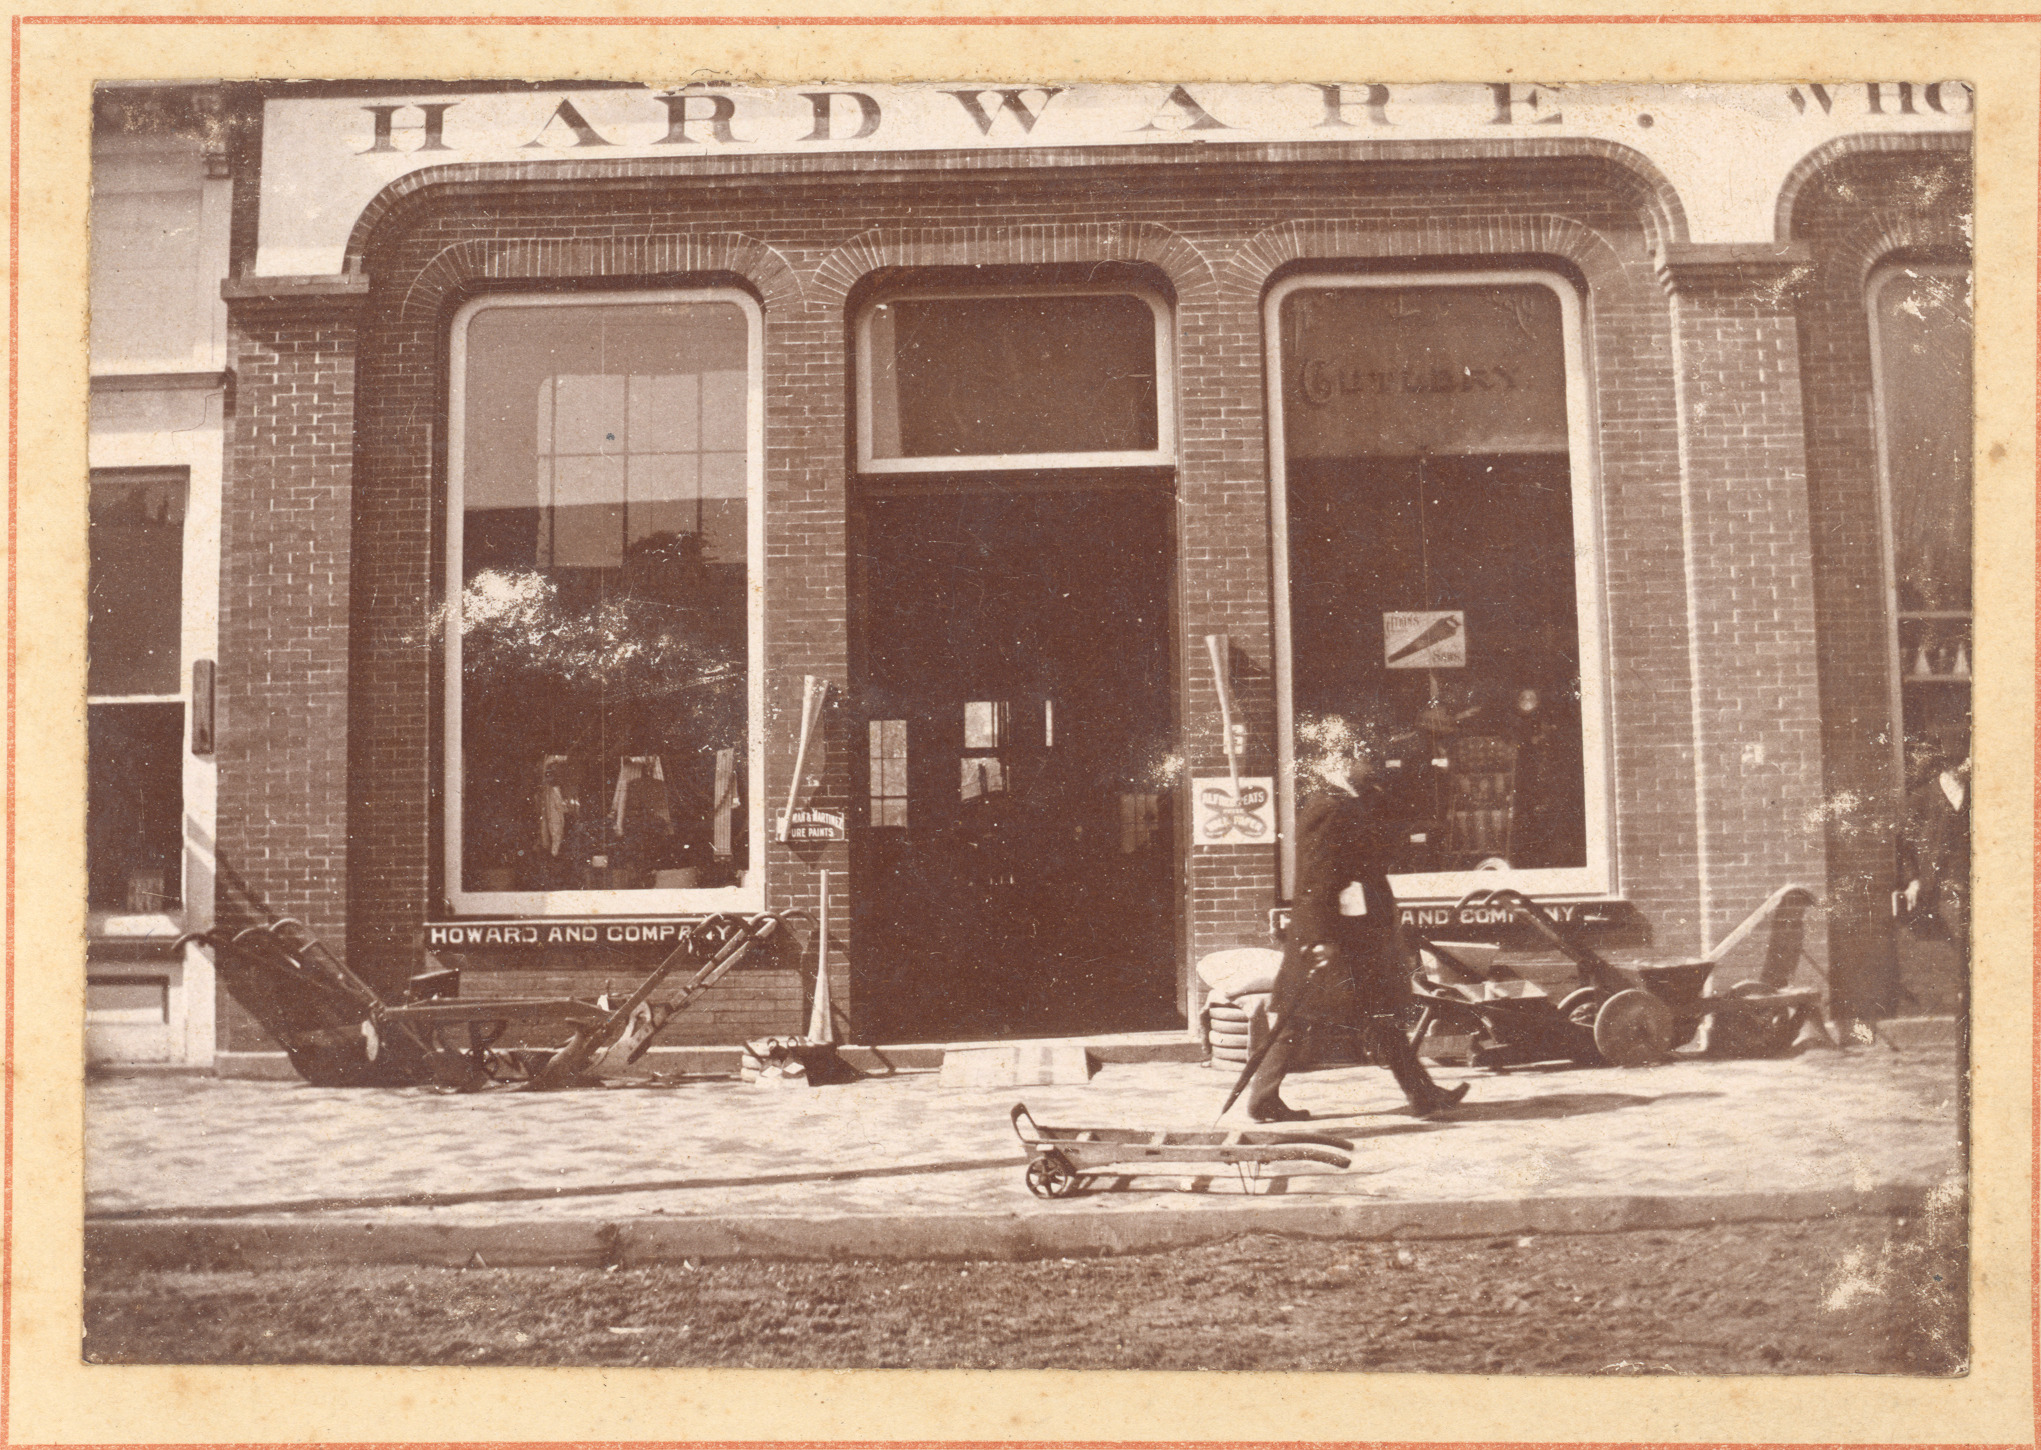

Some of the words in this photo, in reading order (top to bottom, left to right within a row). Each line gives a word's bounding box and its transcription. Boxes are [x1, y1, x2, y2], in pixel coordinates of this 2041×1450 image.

[791, 828, 806, 838] URE
[808, 827, 835, 838] PAINTS
[1401, 908, 1450, 925] AND
[1460, 905, 1575, 924] COMNY
[430, 926, 538, 945] HOWARD
[547, 925, 599, 943] AND
